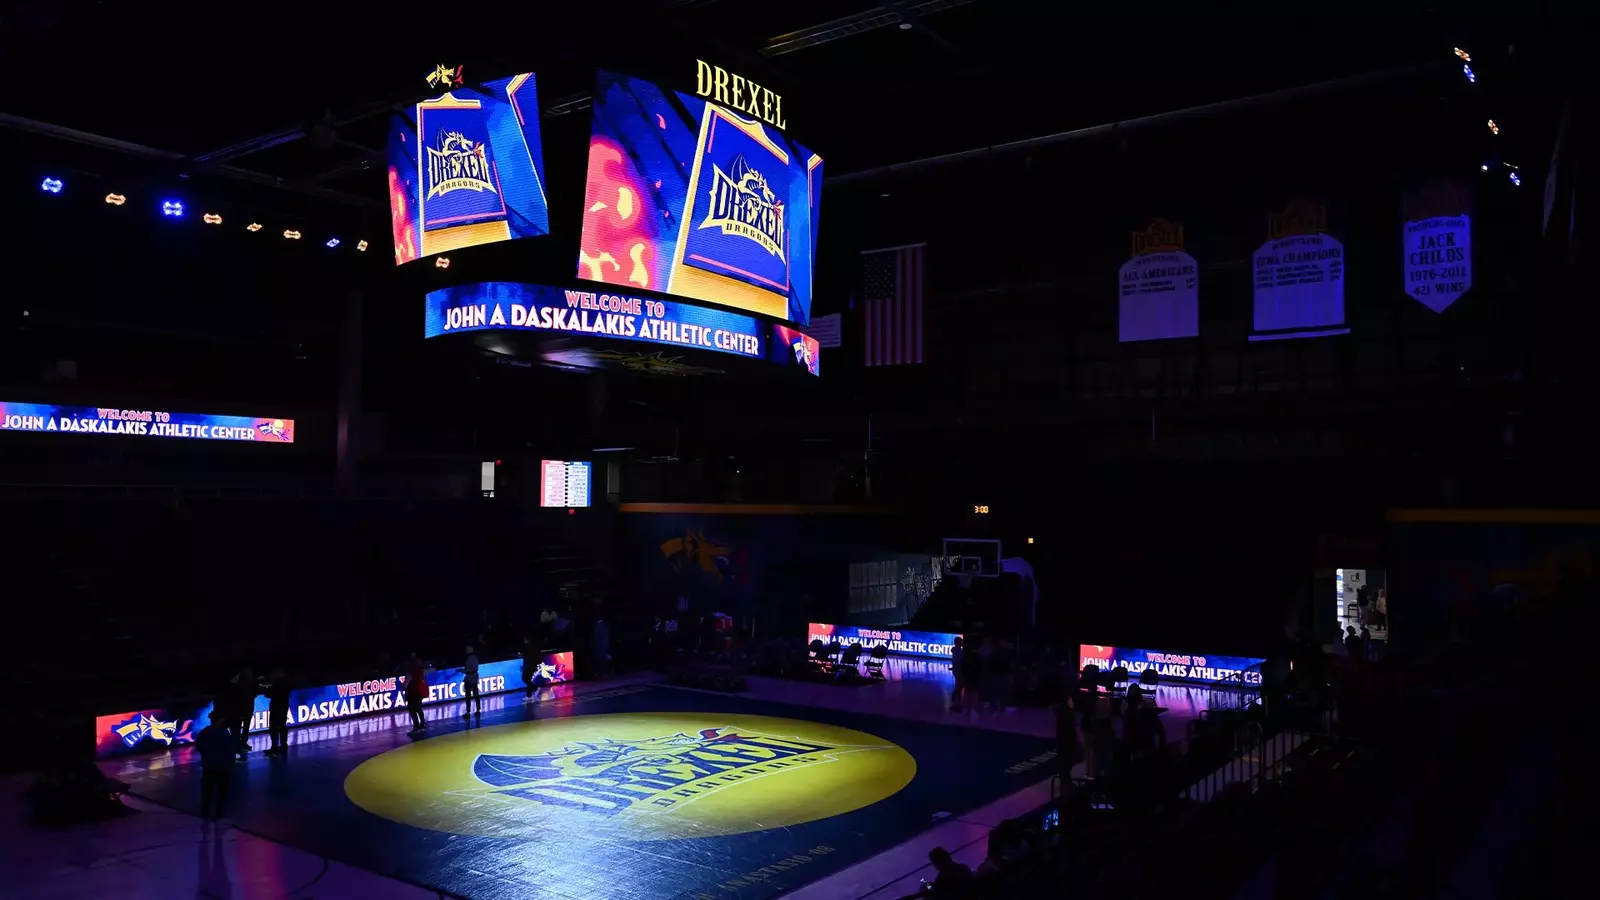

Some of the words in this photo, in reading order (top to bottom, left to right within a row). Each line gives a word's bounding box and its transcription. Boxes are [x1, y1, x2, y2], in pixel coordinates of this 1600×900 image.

[696, 59, 786, 131] DREXEL
[431, 152, 488, 189] DREXEL
[440, 181, 480, 191] DRAGONS
[712, 172, 782, 249] DREXEL
[726, 223, 774, 251] DRAGONS
[1418, 232, 1455, 249] JACK
[1283, 247, 1340, 263] CHAMPIONS
[1410, 248, 1464, 265] CHILDS
[1410, 266, 1466, 281] 1976-2011
[1436, 282, 1465, 294] WINS
[564, 290, 642, 316] WELCOME
[645, 301, 665, 318] TO
[444, 303, 487, 330] JOHN
[489, 303, 507, 325] A
[511, 303, 636, 337] DASKALAKIS
[639, 318, 712, 347] ATHLETIC
[714, 329, 760, 355] CENTER
[97, 408, 152, 421] WELCOME
[154, 411, 170, 423] TO
[2, 415, 44, 430] JOHN
[46, 417, 58, 431] A
[60, 417, 147, 435] DASKALAKIS
[149, 422, 208, 438] ATHLETIC
[211, 426, 255, 440] CENTER
[974, 505, 989, 514] 3:00
[858, 628, 890, 639] WELCOME
[891, 631, 901, 640] TO
[888, 640, 926, 653] ATHLETIC
[1146, 652, 1190, 665] WELCOME
[1192, 655, 1206, 667] TO
[337, 676, 397, 698] WELCOME
[298, 692, 393, 723] DASKALAKIS
[394, 682, 457, 709] AETIC
[459, 675, 505, 697] CNTER
[650, 756, 818, 807] DRAGONS
